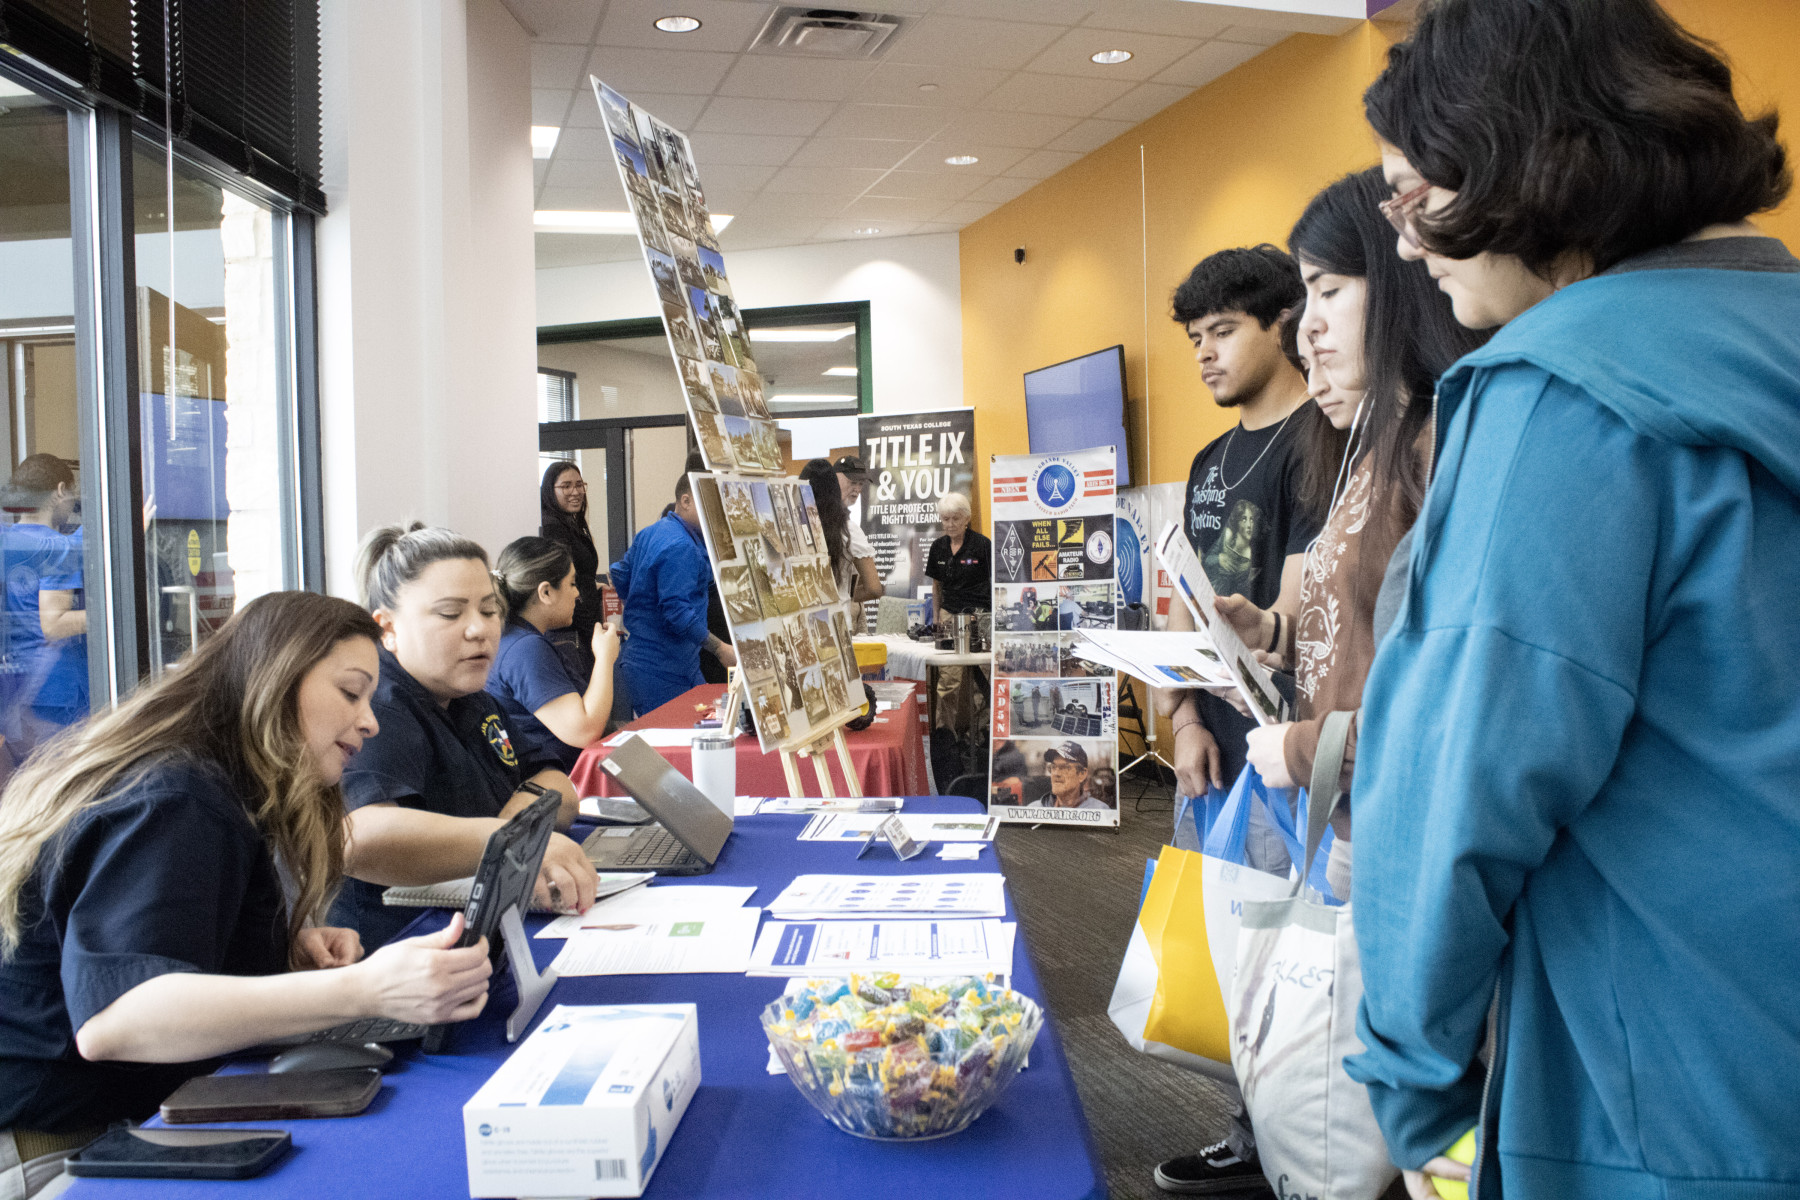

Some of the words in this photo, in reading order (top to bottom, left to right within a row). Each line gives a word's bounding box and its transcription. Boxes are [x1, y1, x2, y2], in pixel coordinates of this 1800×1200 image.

[881, 423, 902, 431] SOUTH
[903, 422, 922, 430] TEXAS
[923, 421, 952, 429] COLLEGE
[866, 433, 933, 469] TITLE
[939, 431, 966, 465] IX
[1038, 457, 1059, 469] GRANDE
[1062, 458, 1080, 477] VALLEY
[876, 470, 897, 500] &
[900, 467, 951, 500] YOU
[870, 505, 889, 515] TITLE
[889, 504, 897, 514] IX
[897, 503, 935, 513] PROTECTS
[1053, 508, 1069, 516] RADIO
[881, 515, 904, 525] RIGHT
[905, 514, 916, 524] TO
[1008, 808, 1101, 821] WWW.RGVARC.ORG
